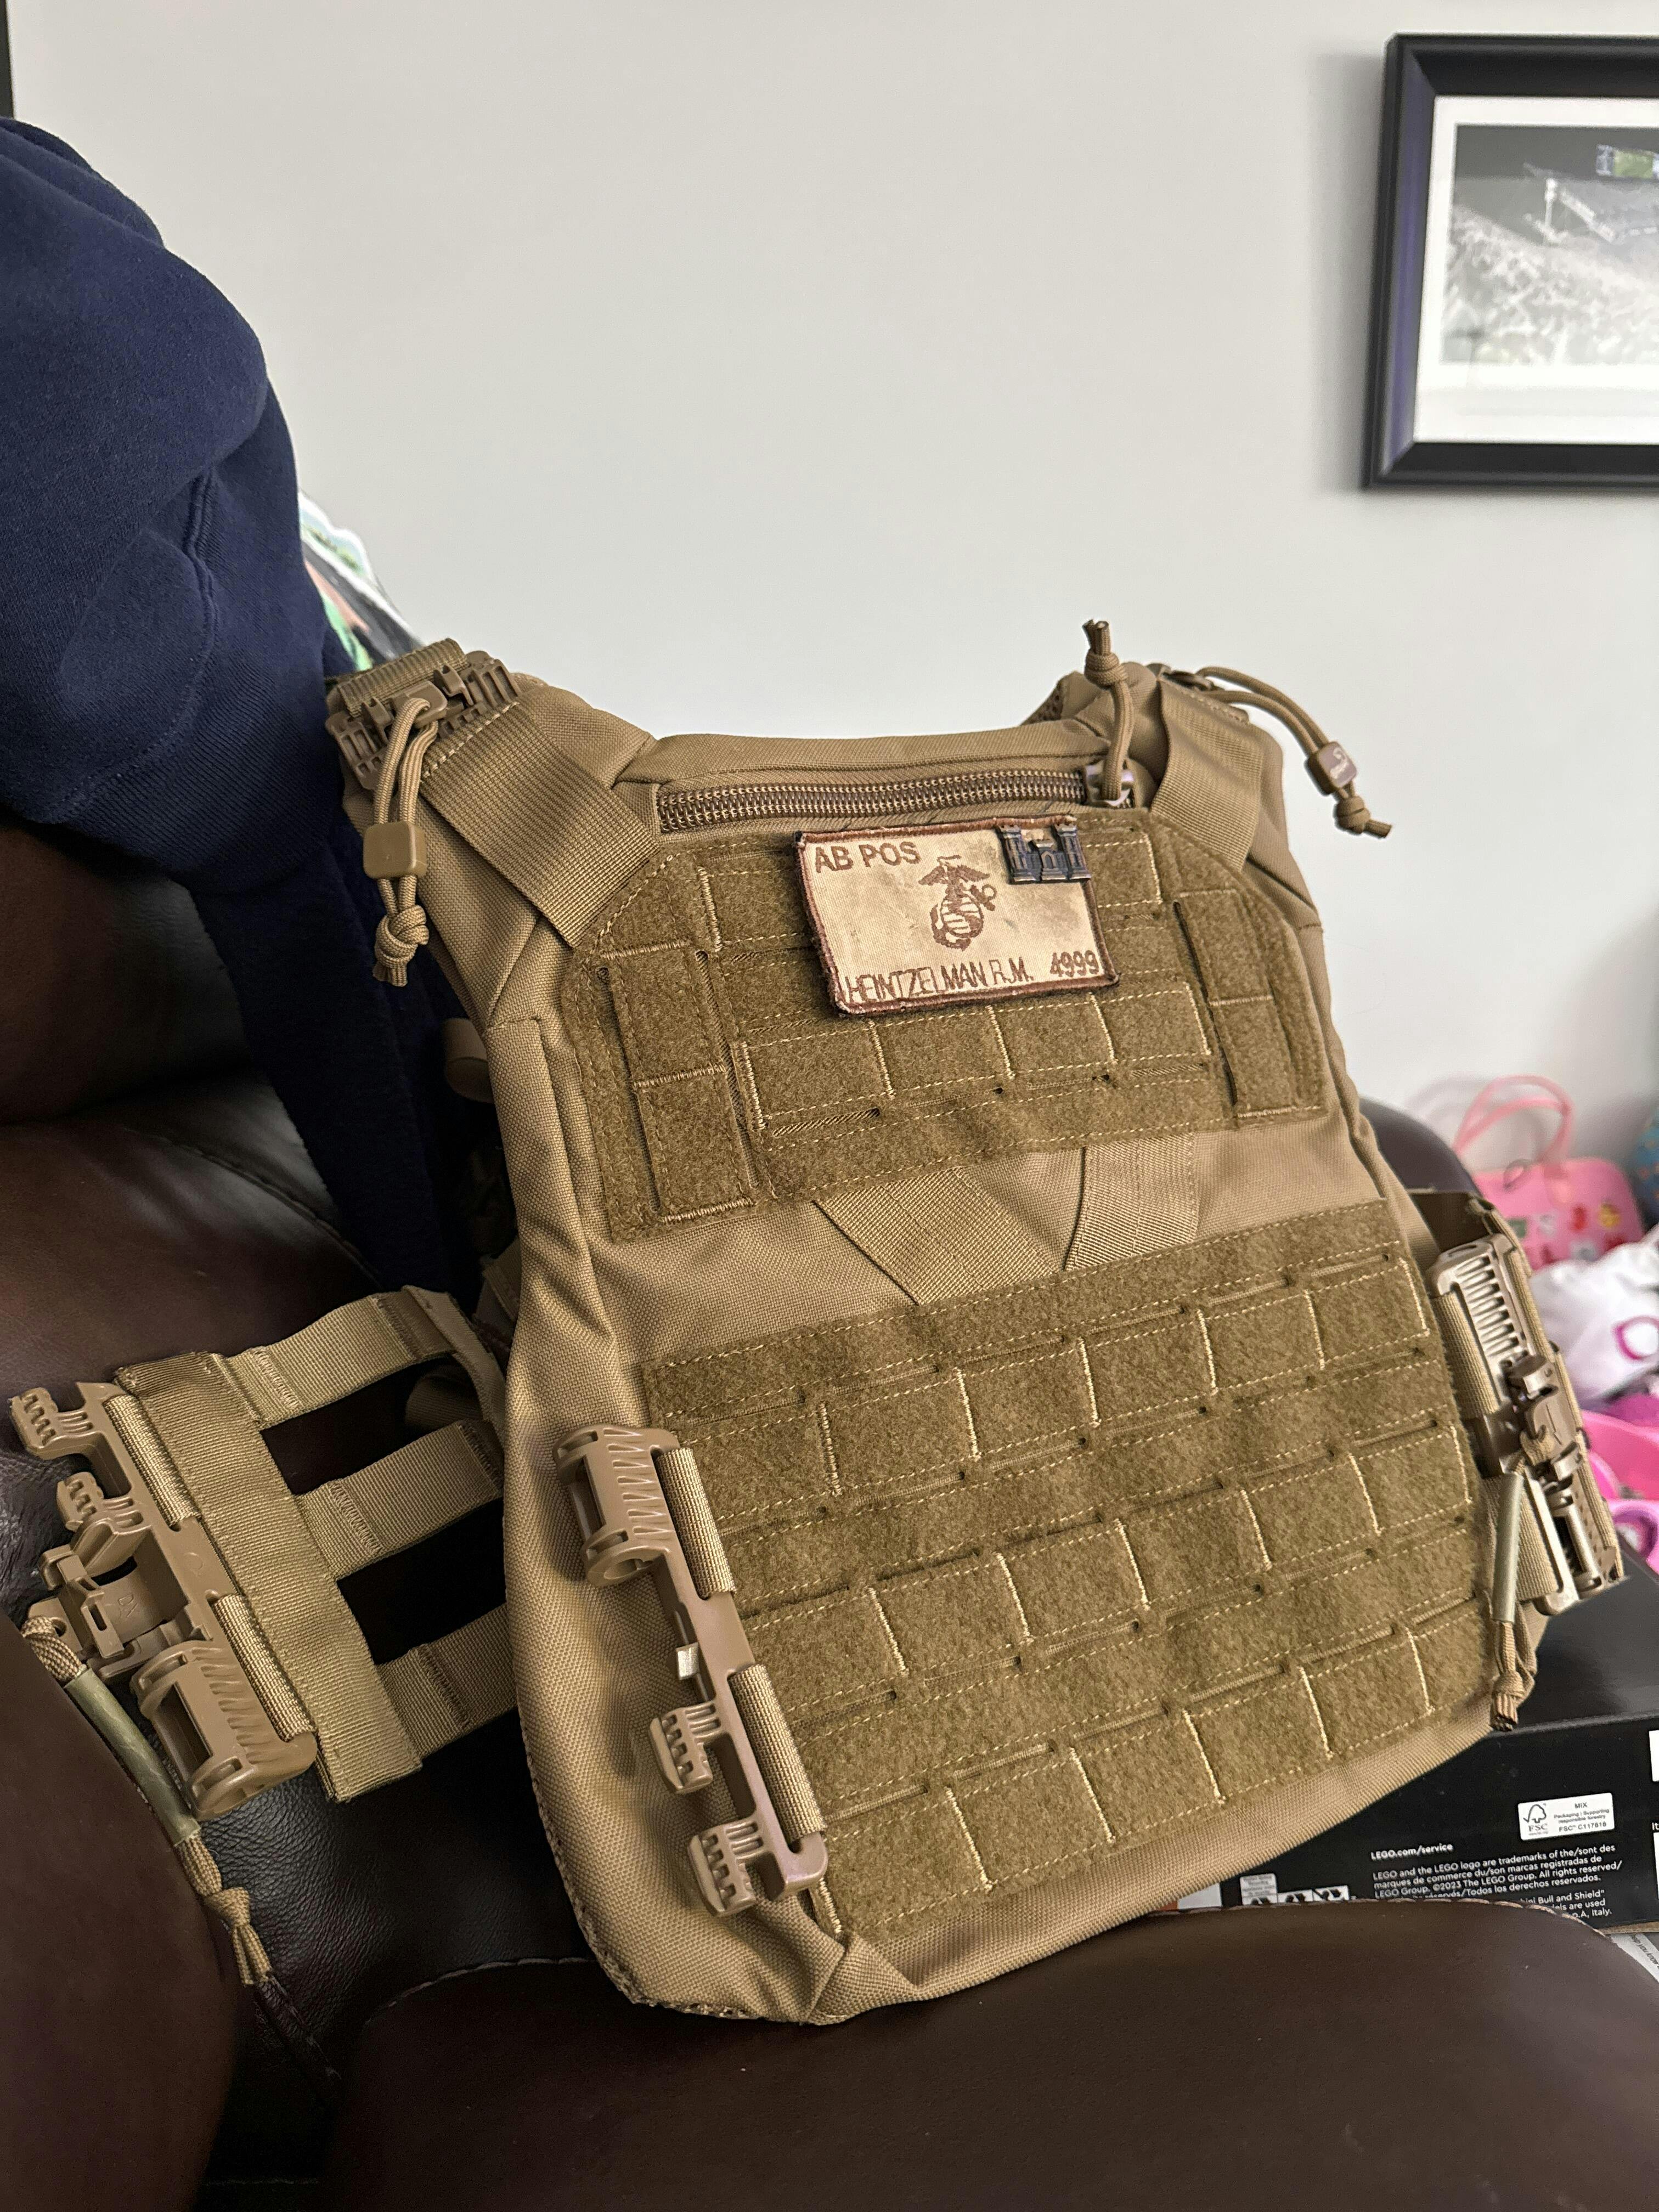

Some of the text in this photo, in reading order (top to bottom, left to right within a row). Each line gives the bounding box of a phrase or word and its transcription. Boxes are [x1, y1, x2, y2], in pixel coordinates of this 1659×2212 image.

[815, 841, 922, 873] AB POS
[845, 961, 989, 1003] HEINTZELMAN
[1049, 950, 1099, 977] 4999
[1528, 1823, 1548, 1832] FSC
[1371, 1843, 1453, 1860] LEGO.com/service
[1373, 1870, 1398, 1881] LEGO
[1400, 1867, 1416, 1877] and
[1418, 1866, 1432, 1875] the
[1434, 1863, 1459, 1873] LEGO
[1460, 1861, 1481, 1870] logo
[1498, 1852, 1547, 1865] trademarks
[1549, 1849, 1558, 1859] of
[1560, 1847, 1598, 1857] the/sont
[1599, 1844, 1615, 1853] des
[1374, 1854, 1602, 1889] marques de commerce du/son marcas registradas de
[1375, 1860, 1622, 1899] LEGO Group. ©2023 The LEGO Group. All rights reserved/
[1494, 1884, 1507, 1893] los
[1509, 1880, 1549, 1892] derechos
[1551, 1874, 1601, 1886] reservados.
[1538, 1894, 1554, 1904] Bull
[1556, 1892, 1572, 1901] and
[1574, 1889, 1604, 1900] Shield"
[1568, 1901, 1582, 1910] are
[1585, 1898, 1605, 1908] used
[1592, 1907, 1612, 1917] Italy.
